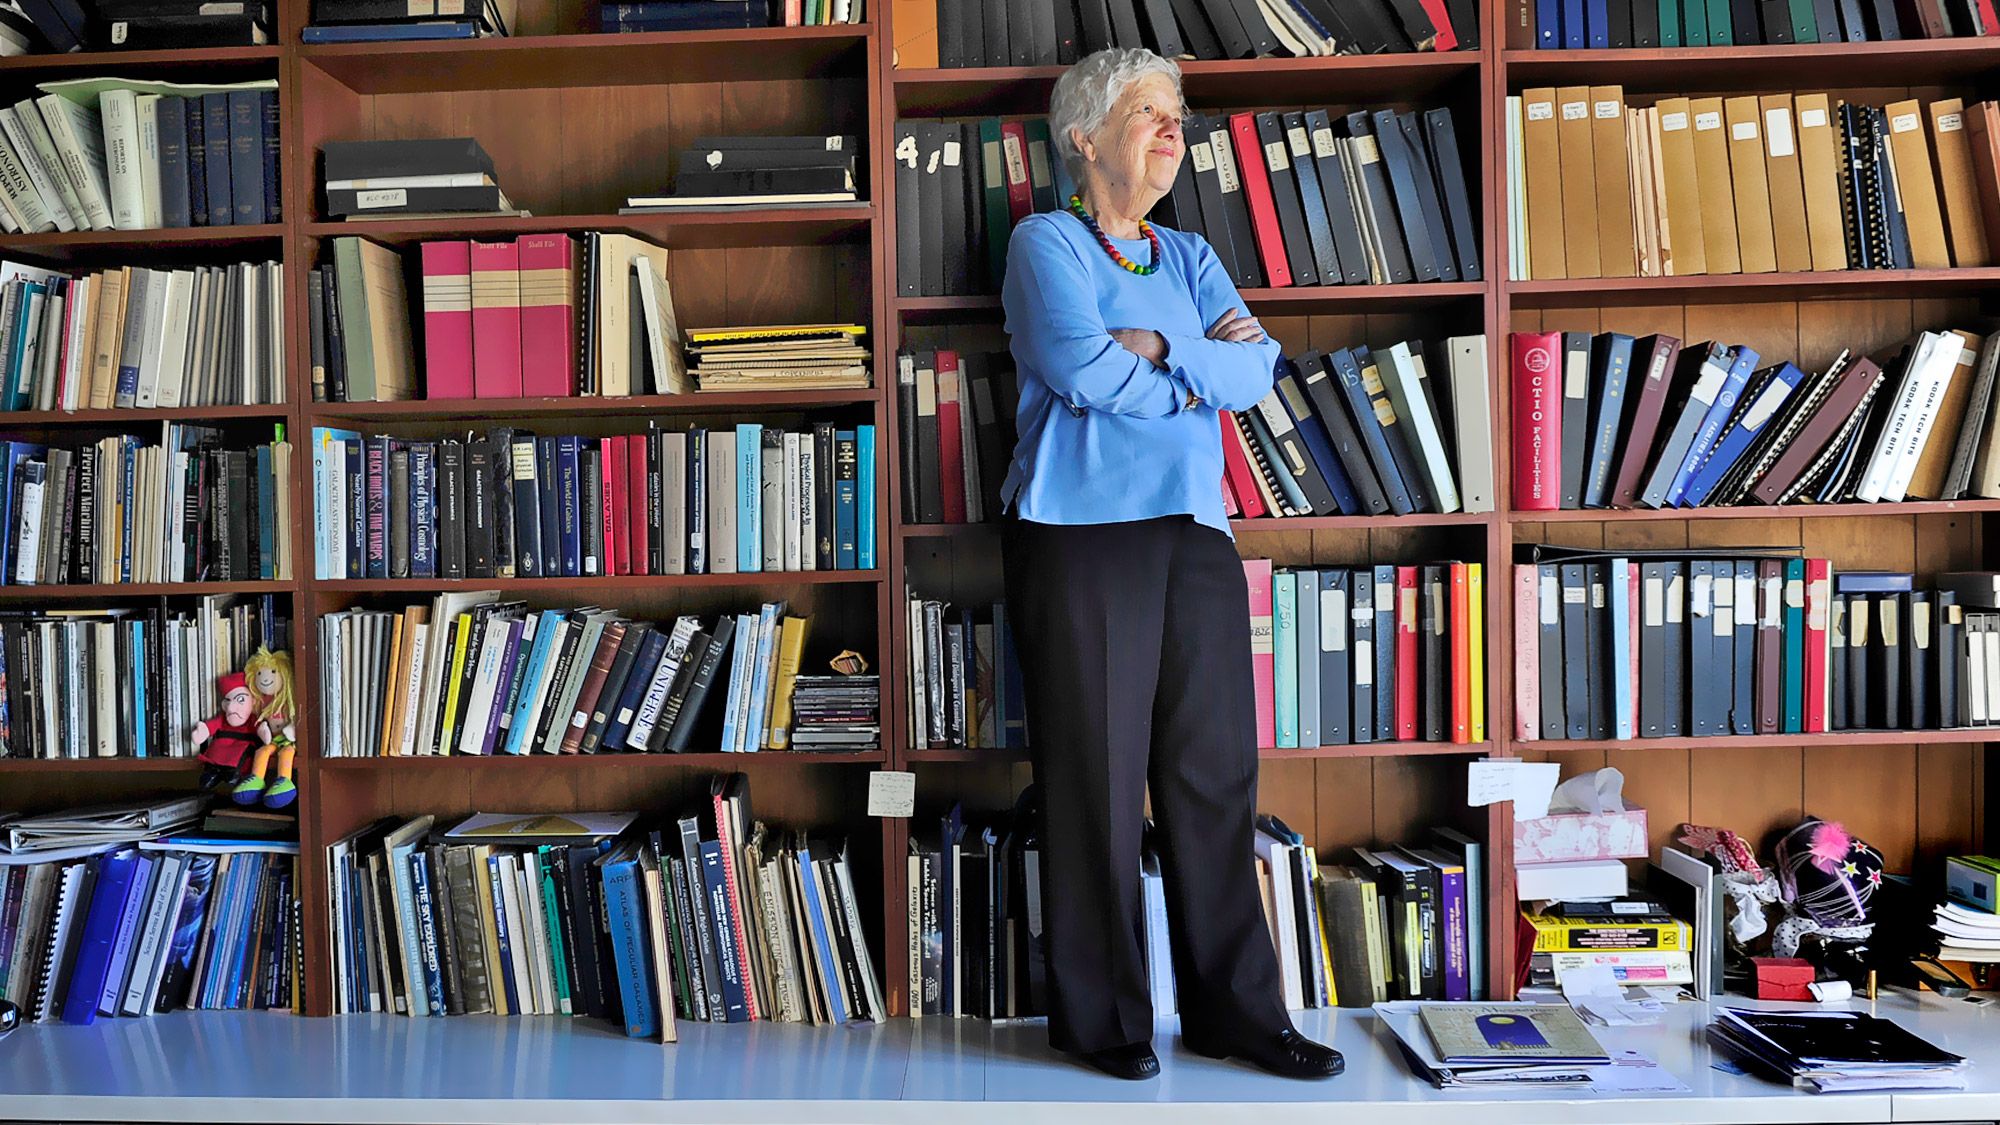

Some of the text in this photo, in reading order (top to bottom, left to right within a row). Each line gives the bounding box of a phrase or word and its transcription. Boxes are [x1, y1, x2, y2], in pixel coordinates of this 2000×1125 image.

[0, 144, 28, 194] ASTRONO
[1532, 376, 1543, 422] CTIO
[1884, 379, 1918, 456] KODAK TECH BITS
[1907, 380, 1939, 455] KODAK TECH BITS
[803, 453, 811, 480] Physical
[1532, 426, 1543, 499] FACILITIES
[1686, 420, 1718, 474] FACILITIES BOOK
[79, 453, 94, 542] Perfect Machine
[353, 473, 362, 494] Nearly
[354, 495, 362, 519] Normal
[368, 450, 383, 560] BLACK HOLES & TIME WARPS
[413, 453, 429, 561] Principles of Physical Cosmology
[564, 499, 572, 507] of
[603, 481, 611, 532] GALAXIES
[564, 507, 573, 534] Galaxies
[504, 652, 526, 714] Dynamics of Galaxies
[557, 659, 565, 670] LIFE
[951, 664, 959, 690] Dialogues
[546, 679, 559, 707] ASTRONOMY
[635, 662, 678, 732] UNIVERSE
[951, 700, 961, 731] Cosmology
[609, 874, 632, 885] ARP
[154, 900, 164, 916] Board
[417, 883, 439, 972] THE SKY EXPLORED
[698, 915, 707, 932] Bright
[619, 890, 644, 1025] ATLAS OF PECULIAR GALAXIES
